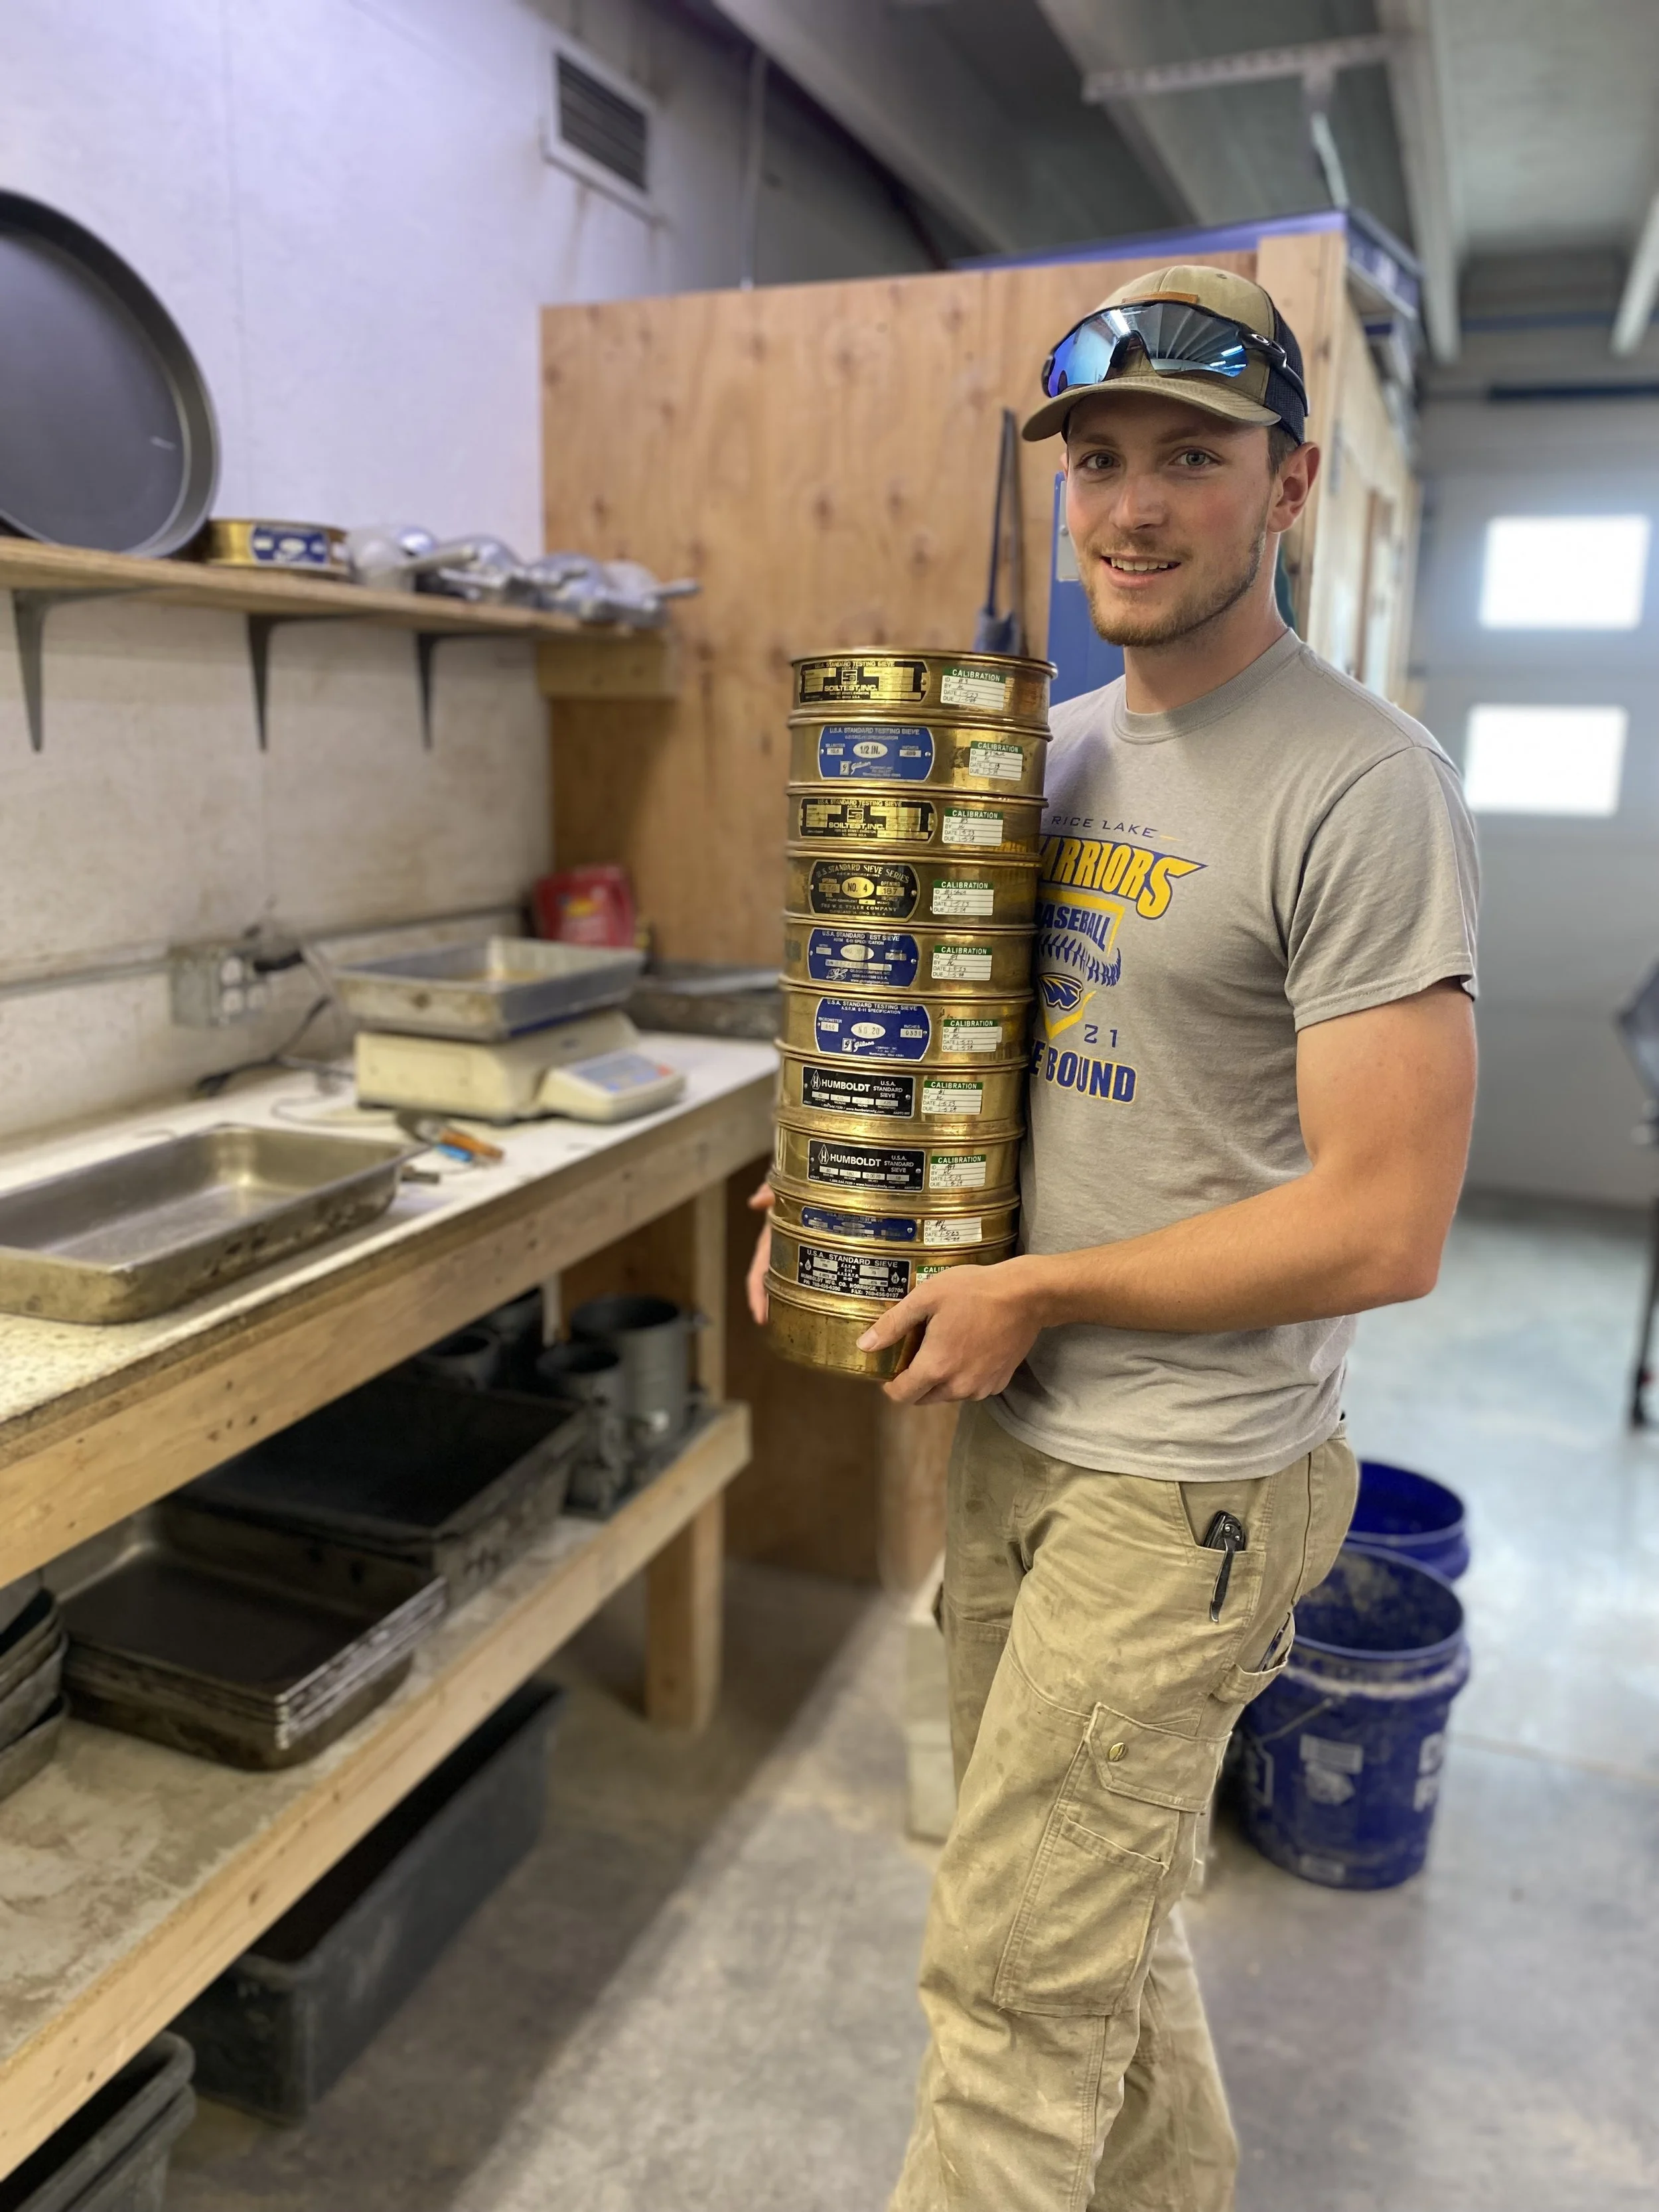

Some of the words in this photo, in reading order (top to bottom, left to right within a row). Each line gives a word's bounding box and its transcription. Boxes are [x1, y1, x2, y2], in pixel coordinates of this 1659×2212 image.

[952, 670, 1000, 682] CALIBRATION
[977, 743, 1019, 753] CALIBRATION
[1052, 816, 1094, 828] RICE
[1102, 820, 1159, 838] LAKE
[828, 863, 860, 873] STANDARD
[863, 865, 883, 875] SIEVE
[886, 869, 910, 883] SERIES
[1039, 834, 1209, 920] ARRIORS
[847, 883, 858, 892] NO.
[863, 883, 868, 893] 4
[1045, 1045, 1136, 1103] BOUND
[822, 1079, 871, 1092] HUMBOLDT
[830, 1153, 881, 1167] HUMBOLDT
[806, 1249, 826, 1258] U.S.A.
[829, 1254, 871, 1266] STANDARD
[800, 1273, 823, 1283] HUMBOLDT
[849, 1283, 878, 1291] NORRIDGE,
